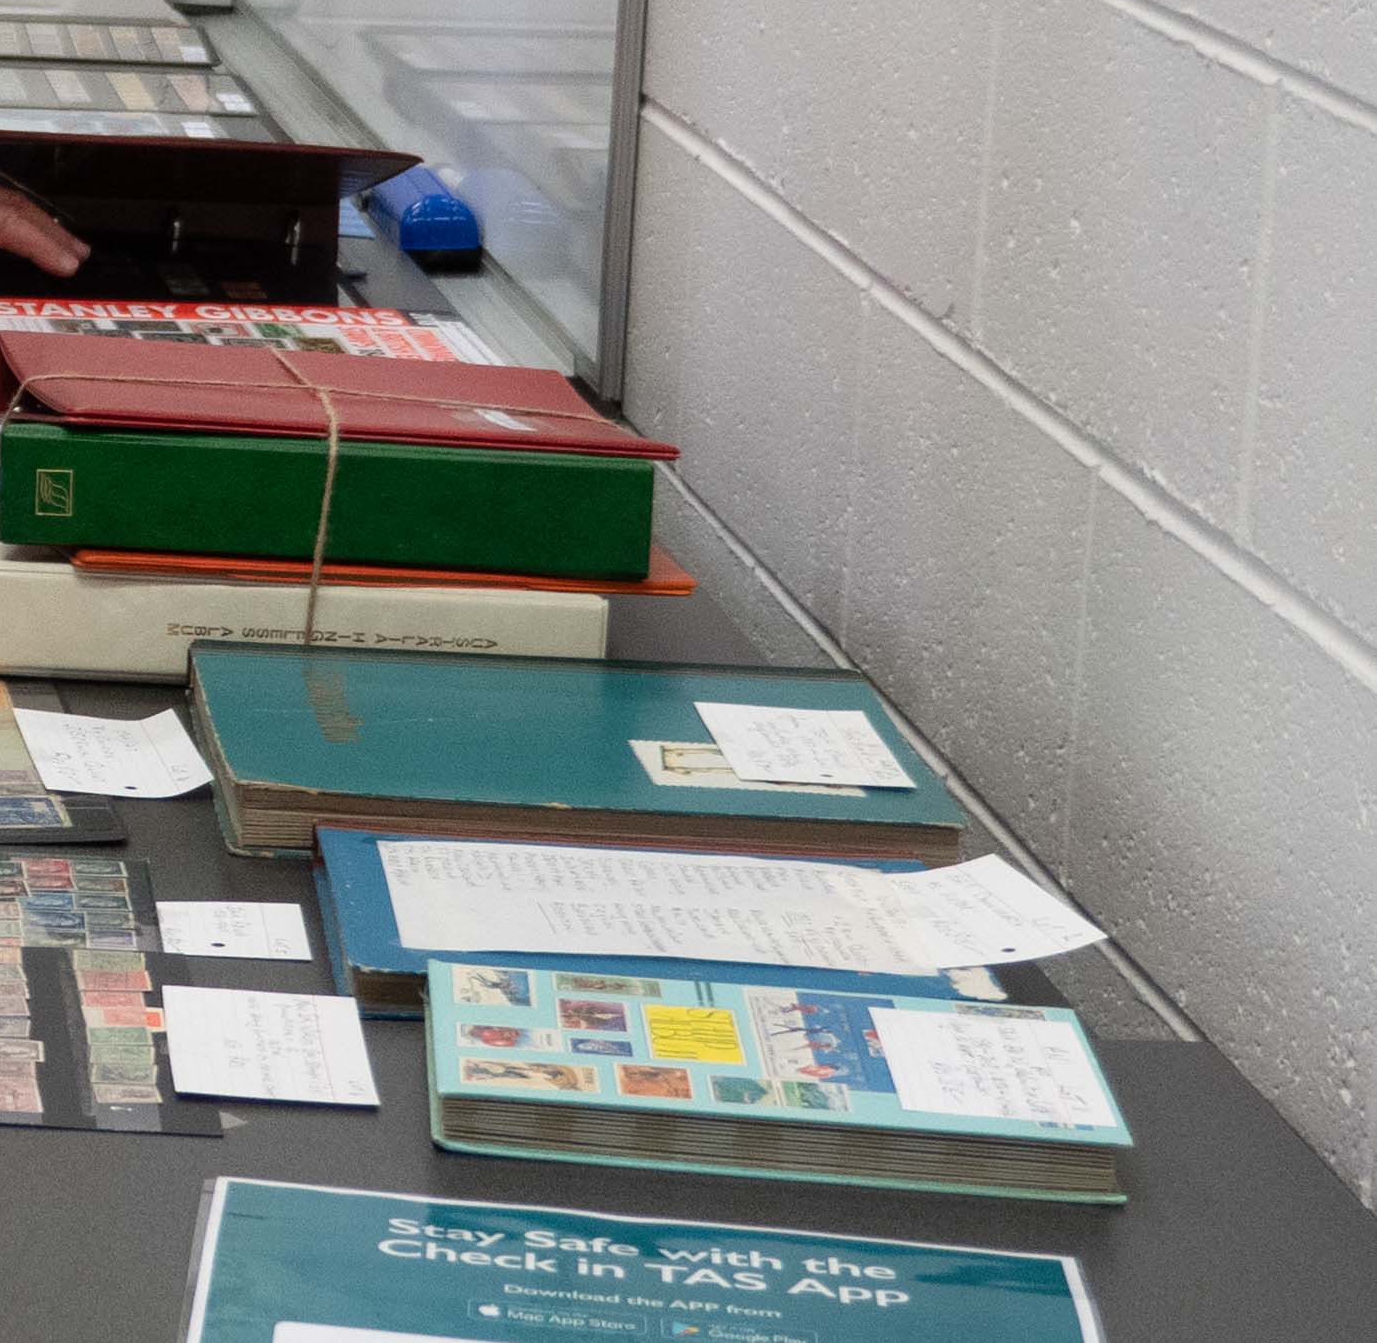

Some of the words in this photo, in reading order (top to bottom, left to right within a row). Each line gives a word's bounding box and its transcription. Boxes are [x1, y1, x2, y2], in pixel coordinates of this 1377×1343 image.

[195, 305, 406, 326] GIBBONS
[166, 622, 234, 638] ALBUM
[376, 631, 499, 650] AUSTRALIA
[388, 1217, 506, 1247] Stay
[524, 1230, 640, 1257] Safe
[658, 1247, 783, 1271] with
[801, 1257, 896, 1280] the
[378, 1238, 558, 1274] Check
[577, 1257, 626, 1280] in
[644, 1263, 767, 1292] TAS
[787, 1277, 910, 1308] App
[503, 1283, 621, 1304] Download
[627, 1295, 664, 1308] the
[668, 1299, 719, 1312] APP
[726, 1304, 782, 1319] from
[507, 1309, 544, 1323] Mac
[548, 1314, 585, 1326] App
[588, 1318, 638, 1331] Store
[708, 1328, 770, 1343] Google
